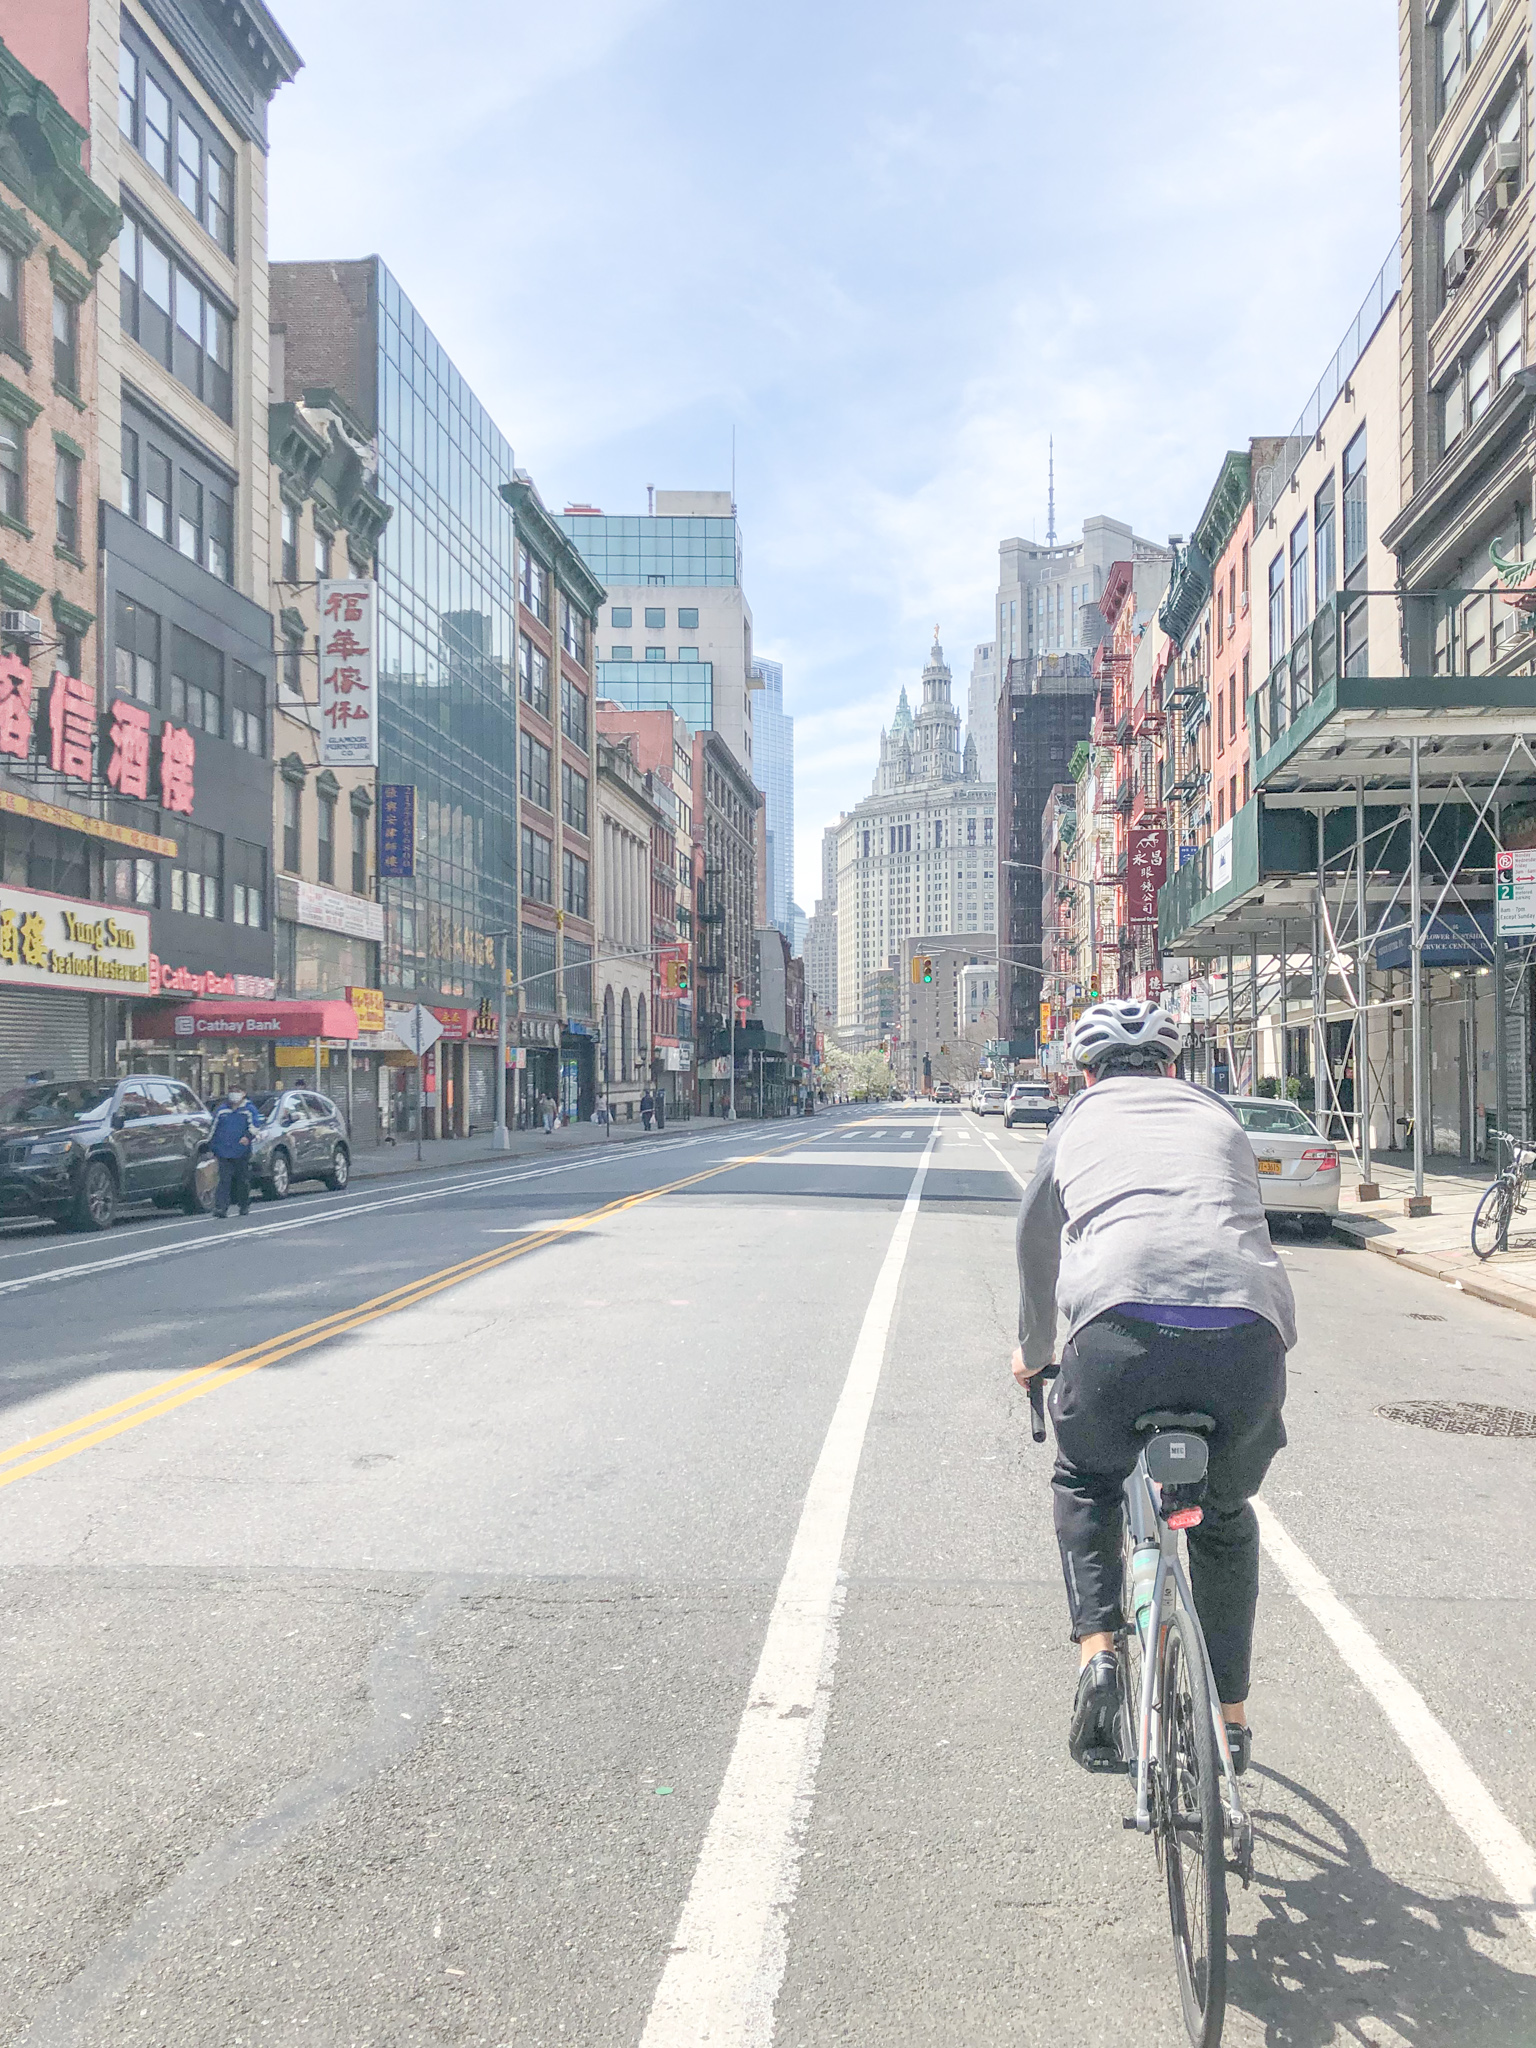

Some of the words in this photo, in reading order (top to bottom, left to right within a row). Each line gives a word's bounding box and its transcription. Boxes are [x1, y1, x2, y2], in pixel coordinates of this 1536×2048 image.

[1132, 850, 1163, 866] 永昌
[1140, 866, 1154, 915] 眼鏡公司
[1501, 886, 1510, 900] 2
[1518, 912, 1536, 920] Sunday
[63, 910, 104, 951] Yung
[107, 917, 136, 949] Sun
[51, 949, 96, 978] Seafood
[196, 1018, 244, 1033] Cathay
[246, 1017, 281, 1031] Bank
